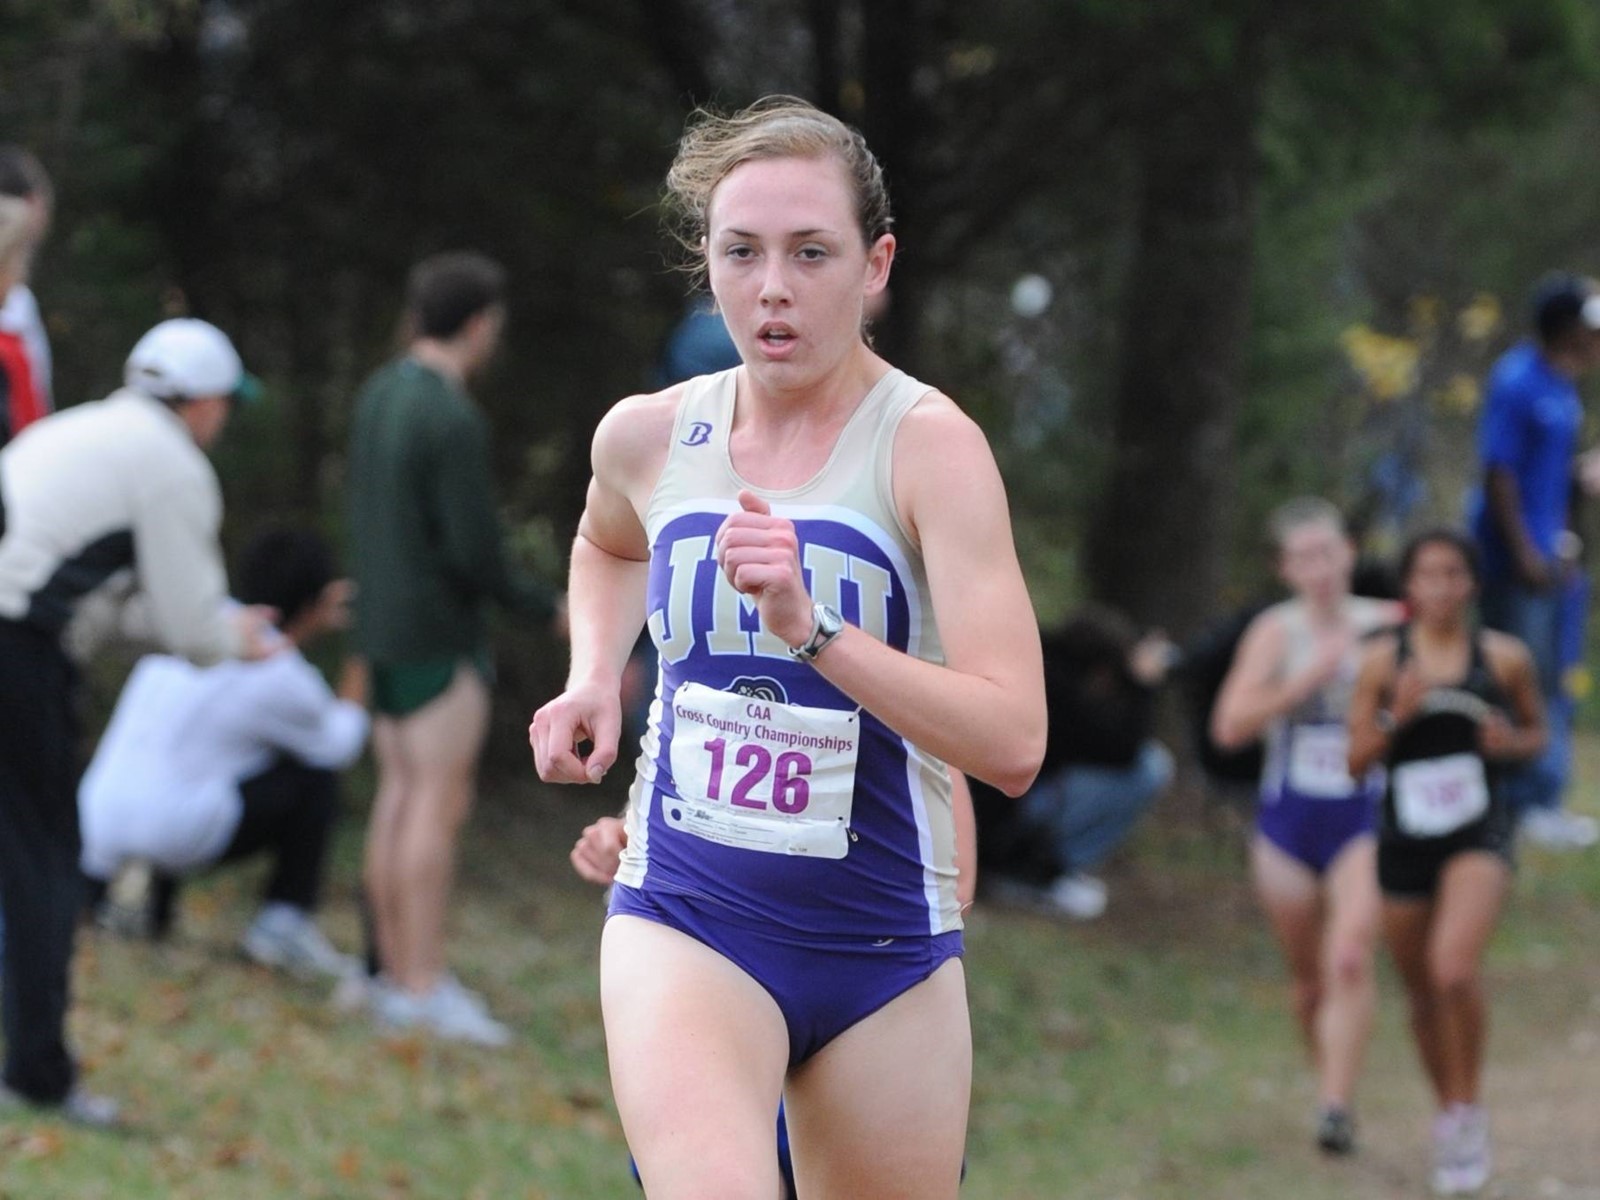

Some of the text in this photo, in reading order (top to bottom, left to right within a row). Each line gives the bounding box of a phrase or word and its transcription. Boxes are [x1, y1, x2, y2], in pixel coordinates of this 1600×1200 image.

[675, 704, 853, 754] Cross Country Championships
[746, 703, 771, 721] CAA
[703, 737, 812, 815] 126
